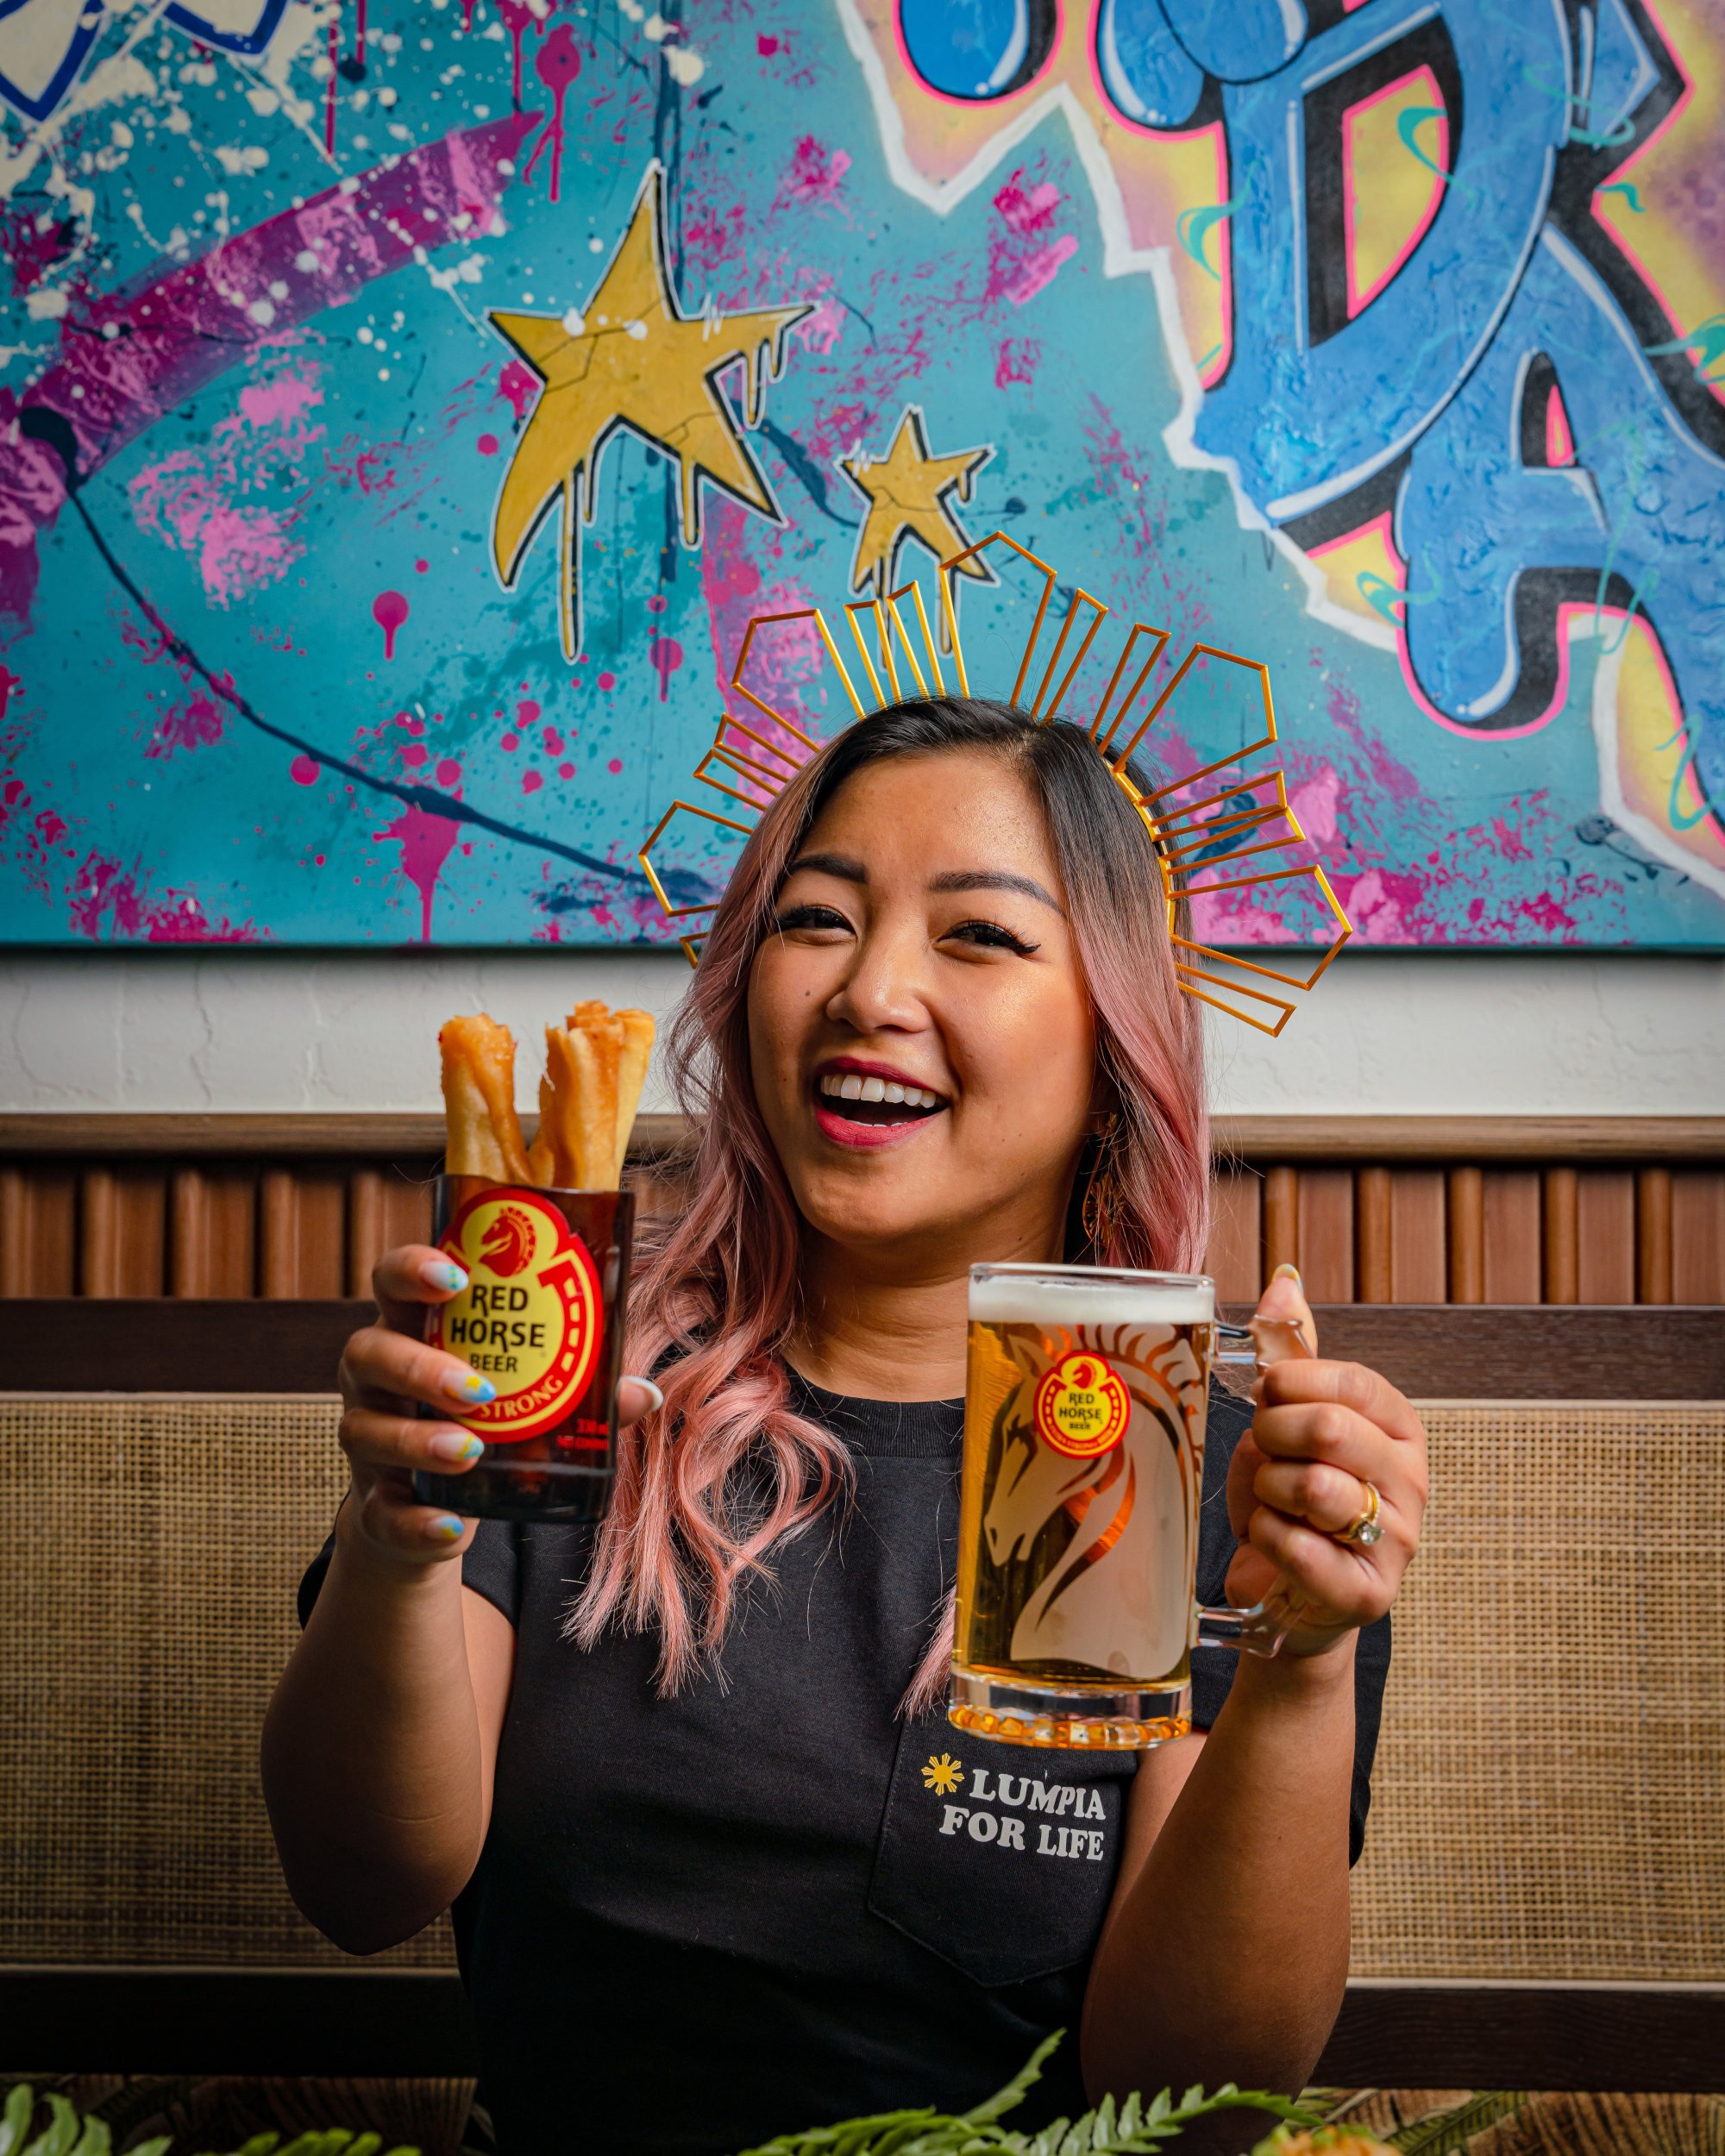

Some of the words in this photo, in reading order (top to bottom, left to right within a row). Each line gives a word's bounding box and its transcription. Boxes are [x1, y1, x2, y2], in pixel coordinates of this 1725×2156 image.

[471, 1284, 529, 1317] RED
[451, 1317, 545, 1353] HORSE
[470, 1353, 518, 1372] BEER
[480, 1375, 563, 1418] STRONG
[1069, 1393, 1095, 1406] RED
[1059, 1407, 1102, 1421] HORSE
[969, 1769, 1106, 1820] LUMPIA
[938, 1804, 1026, 1850] FOR
[1037, 1824, 1104, 1861] LIFE
